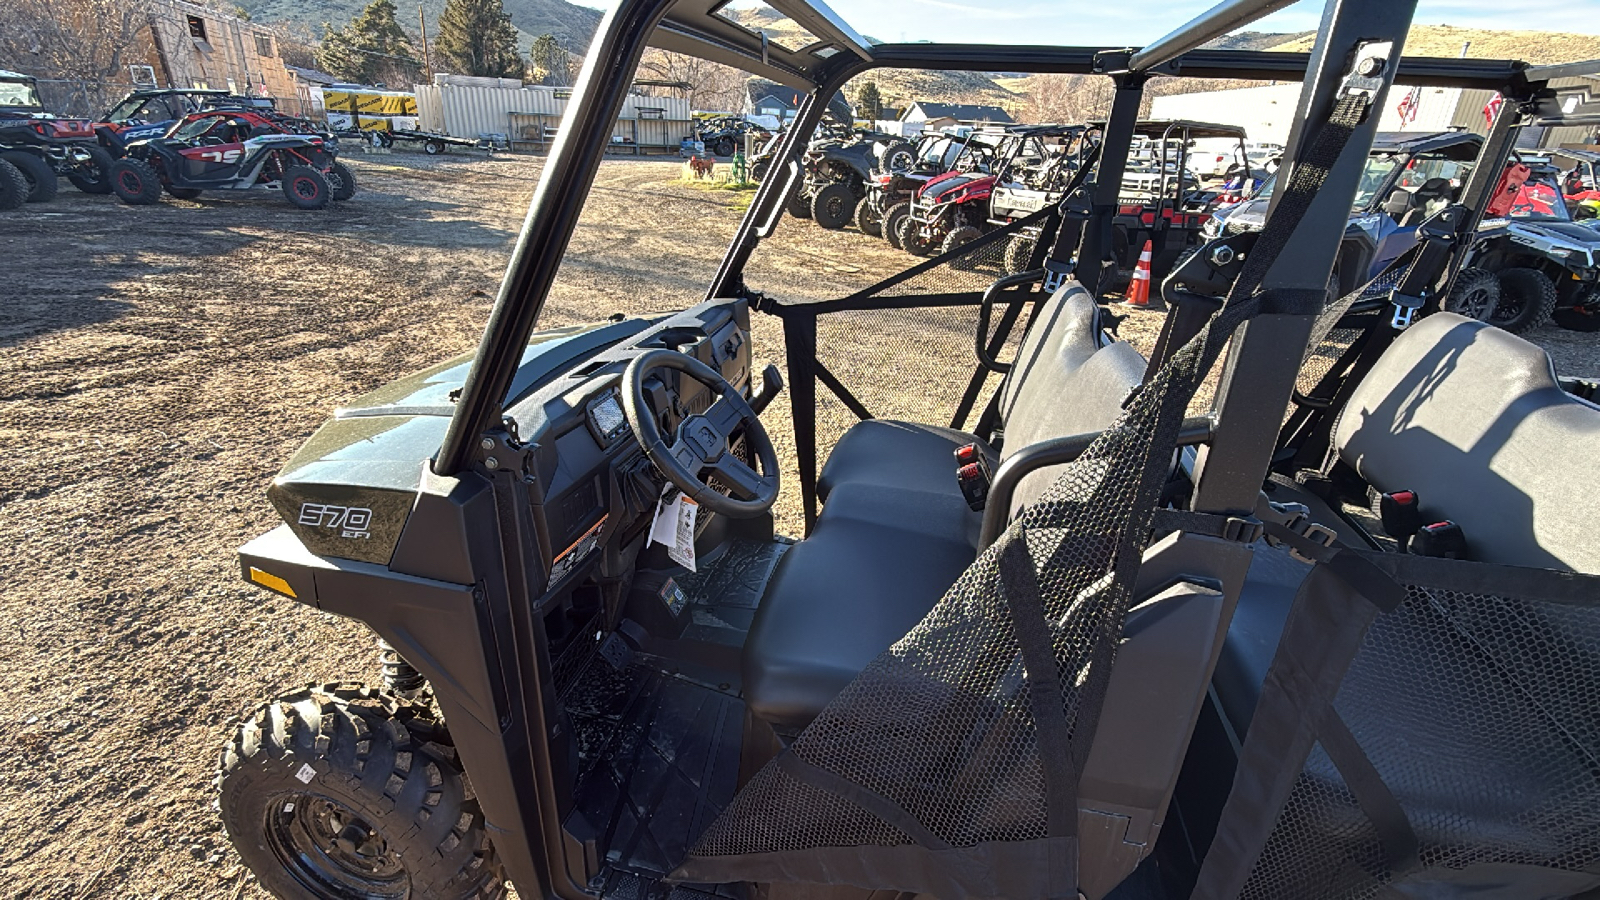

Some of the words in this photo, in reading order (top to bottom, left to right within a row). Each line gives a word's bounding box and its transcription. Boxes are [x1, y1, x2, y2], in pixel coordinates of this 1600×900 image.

[125, 127, 165, 140] RZR
[1358, 216, 1380, 224] XP
[298, 503, 372, 531] 570
[341, 530, 371, 539] EFI
